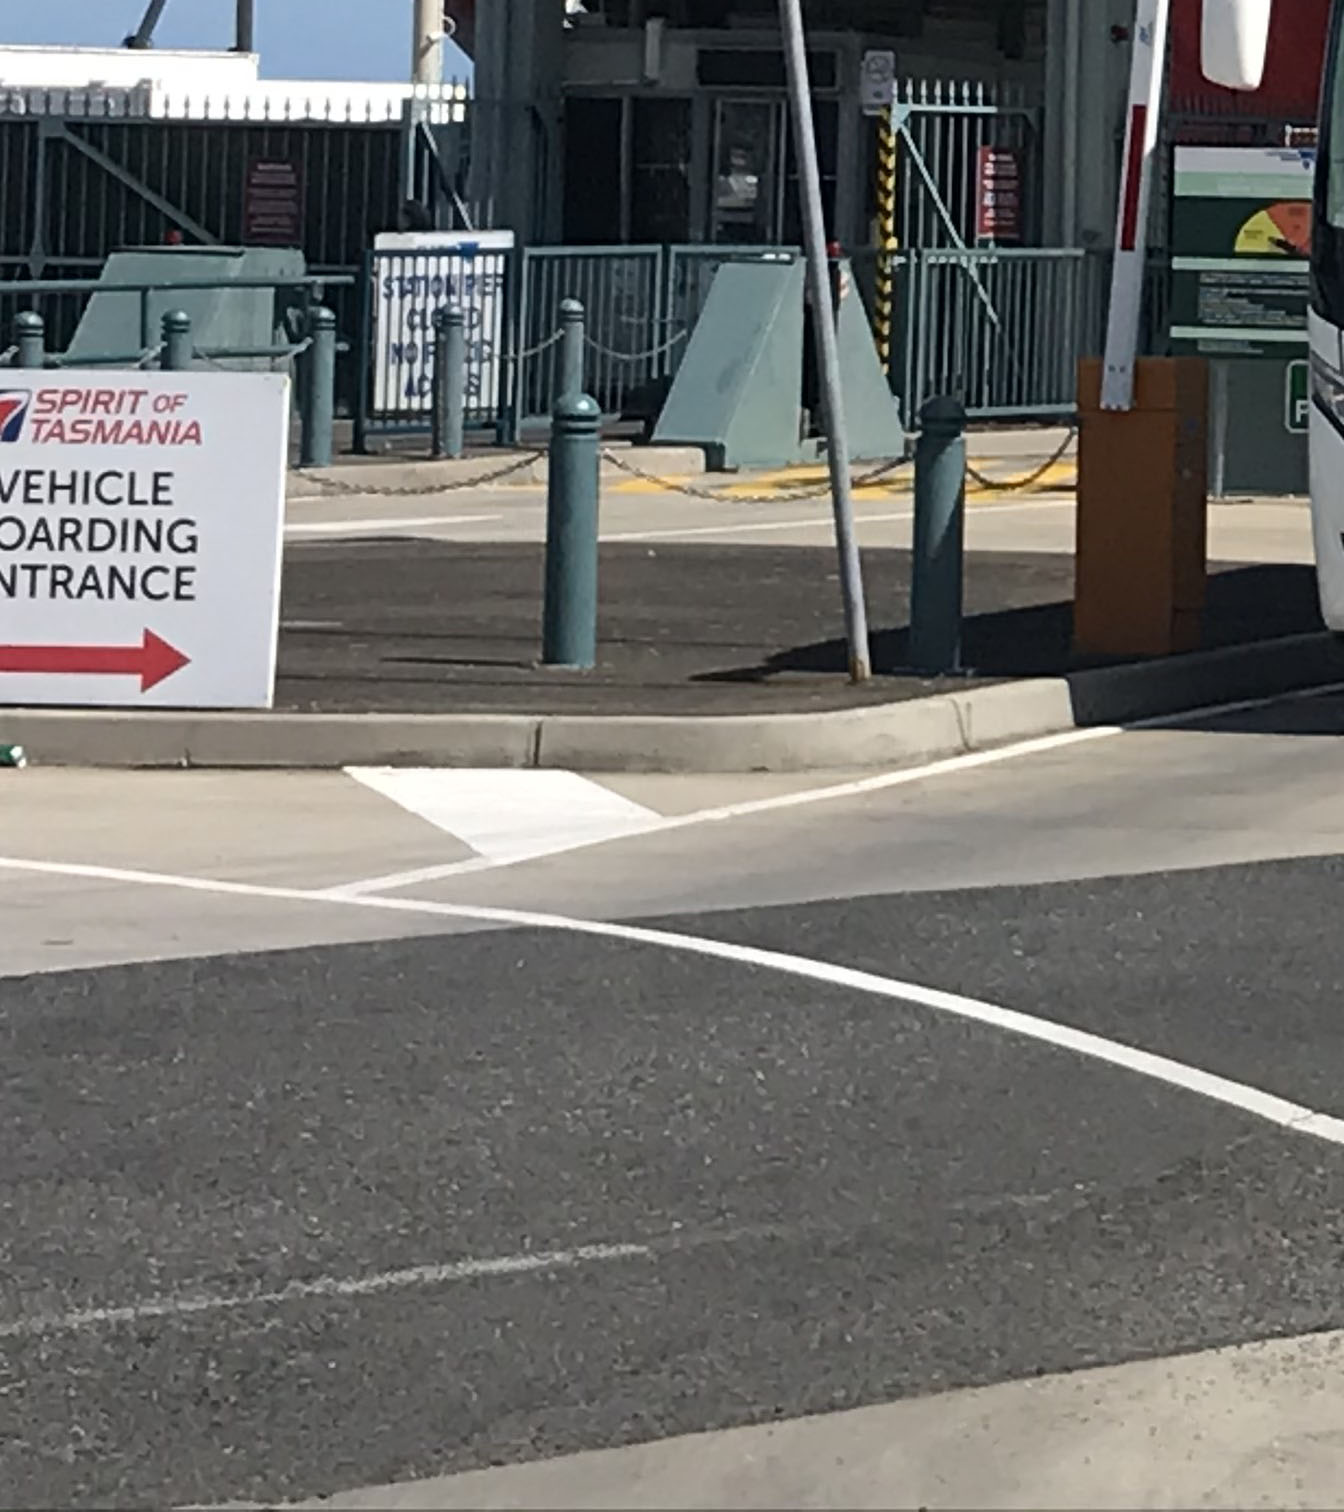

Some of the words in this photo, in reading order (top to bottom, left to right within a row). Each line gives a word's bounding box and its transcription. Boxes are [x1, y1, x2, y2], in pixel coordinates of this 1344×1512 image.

[33, 389, 148, 414] SPIRIT
[152, 394, 188, 413] OF
[31, 419, 203, 445] TASMANIA
[0, 469, 174, 506] VEHICLE
[0, 515, 199, 554] OARDING
[0, 563, 197, 602] NTRANCE
